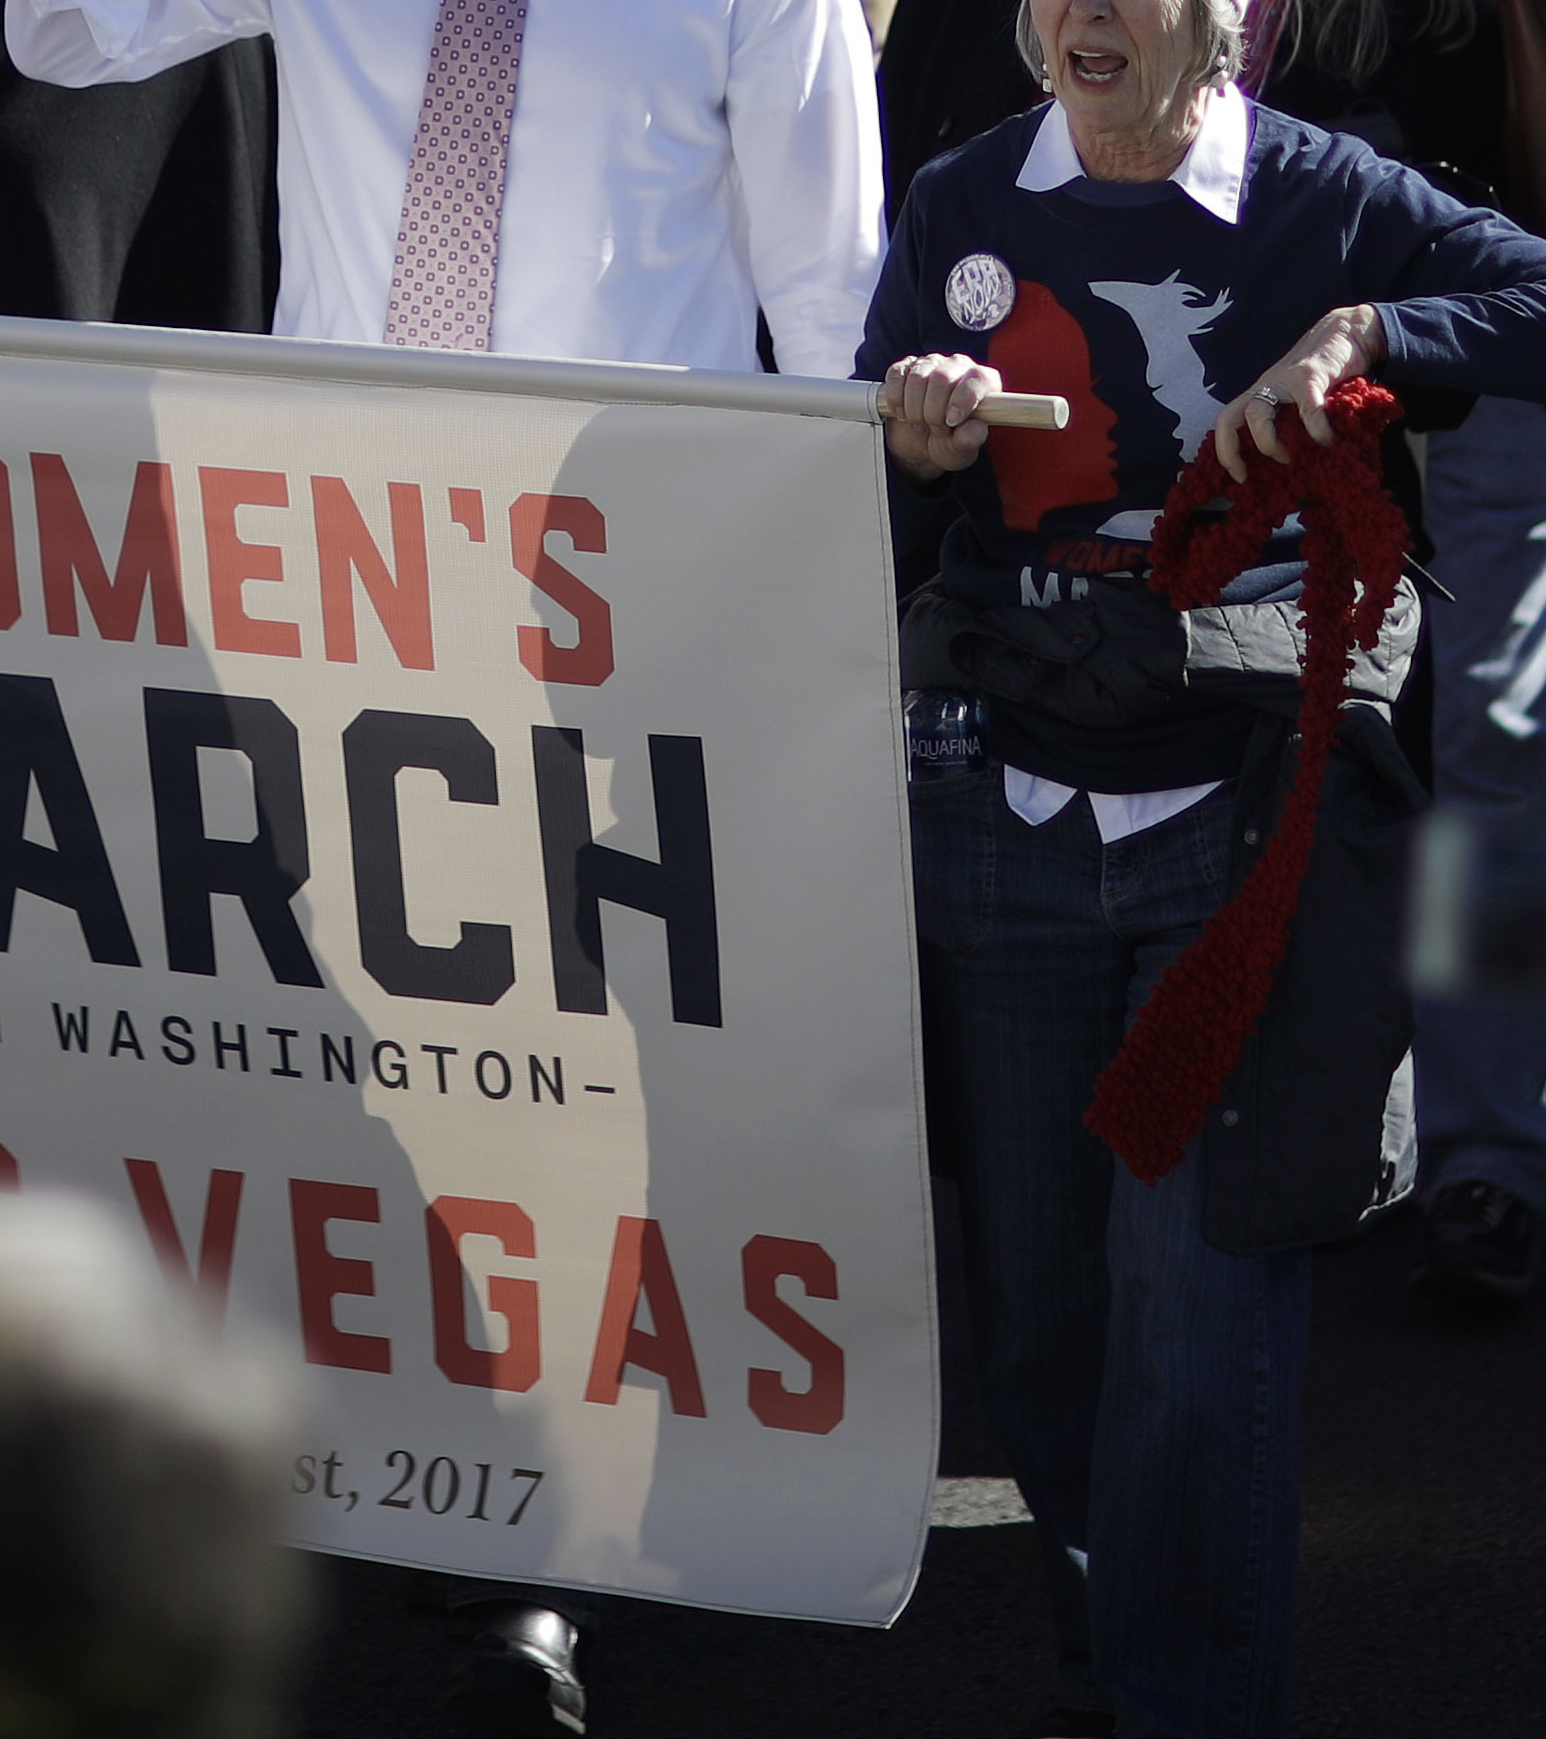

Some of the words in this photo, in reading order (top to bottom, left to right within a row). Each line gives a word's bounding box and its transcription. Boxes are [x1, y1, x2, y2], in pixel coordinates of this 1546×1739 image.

[910, 735, 983, 760] AQUAFINA
[123, 1157, 846, 1435] VEGAS
[377, 1449, 545, 1526] 2017
